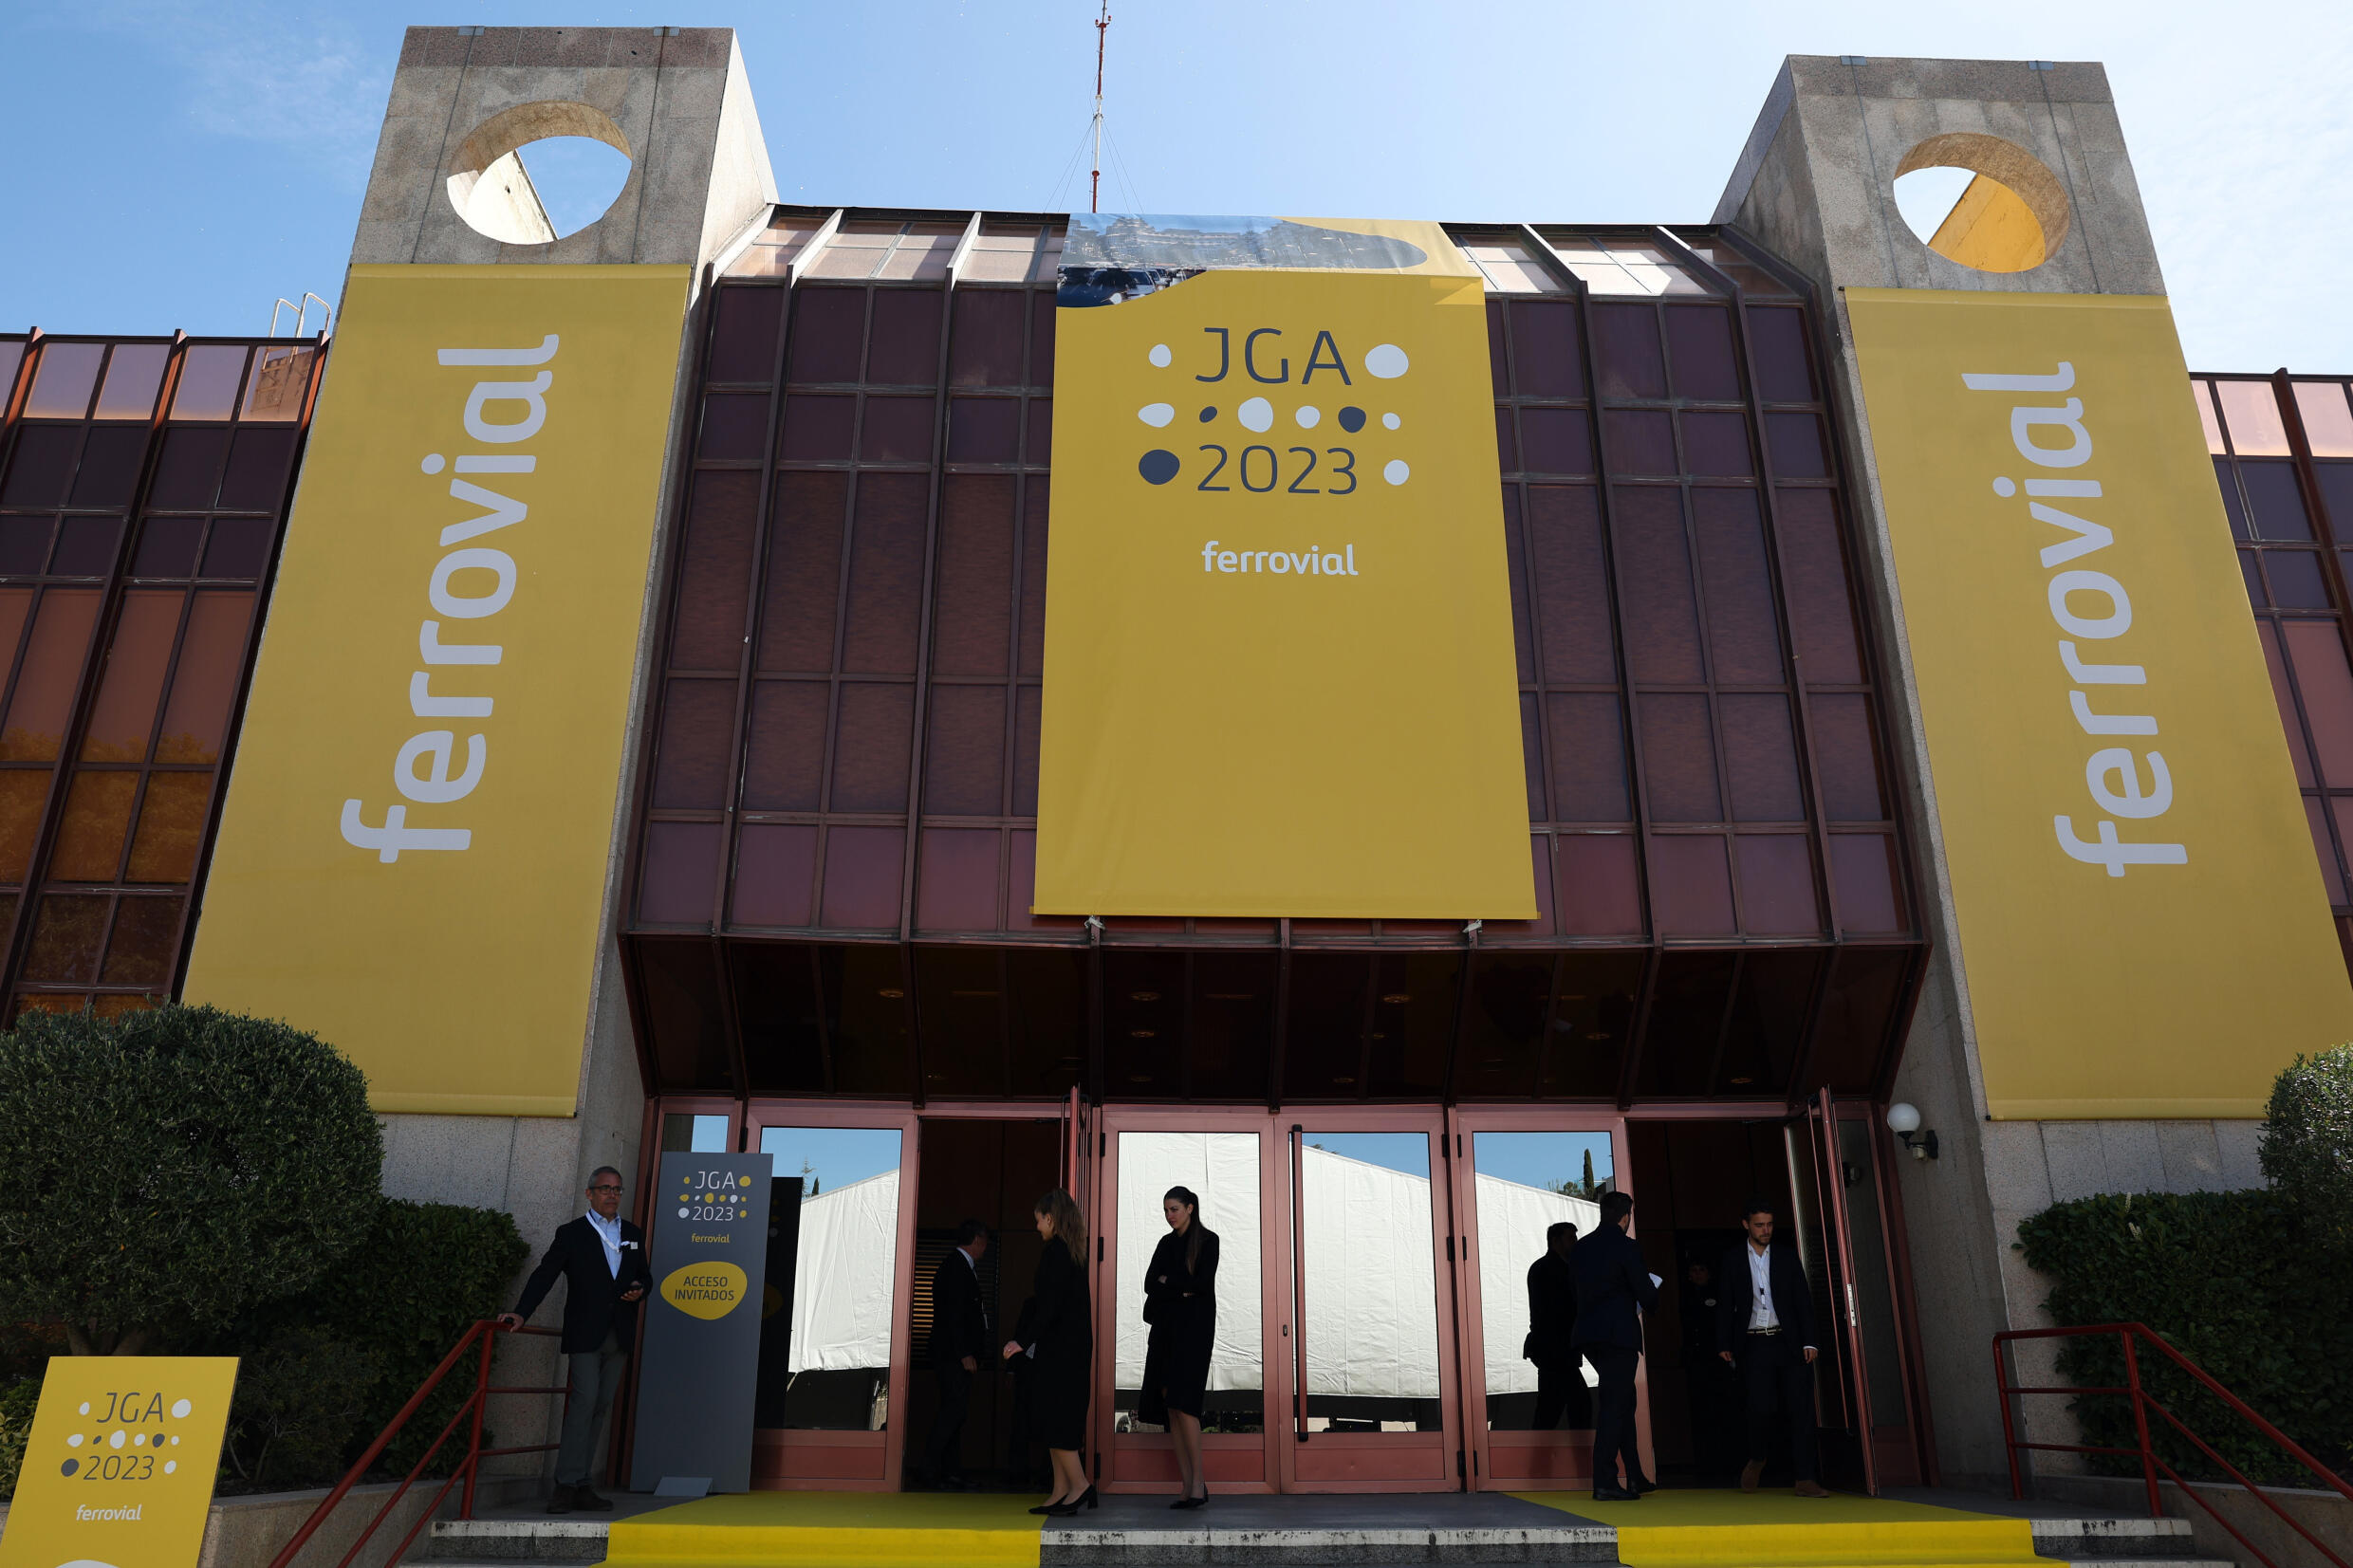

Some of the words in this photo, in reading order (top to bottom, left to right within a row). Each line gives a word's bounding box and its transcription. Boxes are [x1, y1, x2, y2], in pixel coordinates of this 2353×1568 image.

[1195, 327, 1352, 385] JGA
[1197, 444, 1357, 495] 2023
[1201, 540, 1359, 576] ferrovial
[340, 334, 560, 863] ferrovial
[1961, 360, 2188, 877] ferrovial
[695, 1171, 735, 1190] JGA
[692, 1206, 733, 1221] 2023
[691, 1233, 730, 1243] ferrovial
[683, 1276, 728, 1287] ACCESO
[675, 1289, 734, 1301] INVITADOS
[96, 1392, 164, 1423] JGA
[83, 1455, 155, 1481] 2023
[76, 1504, 142, 1521] ferrovial
